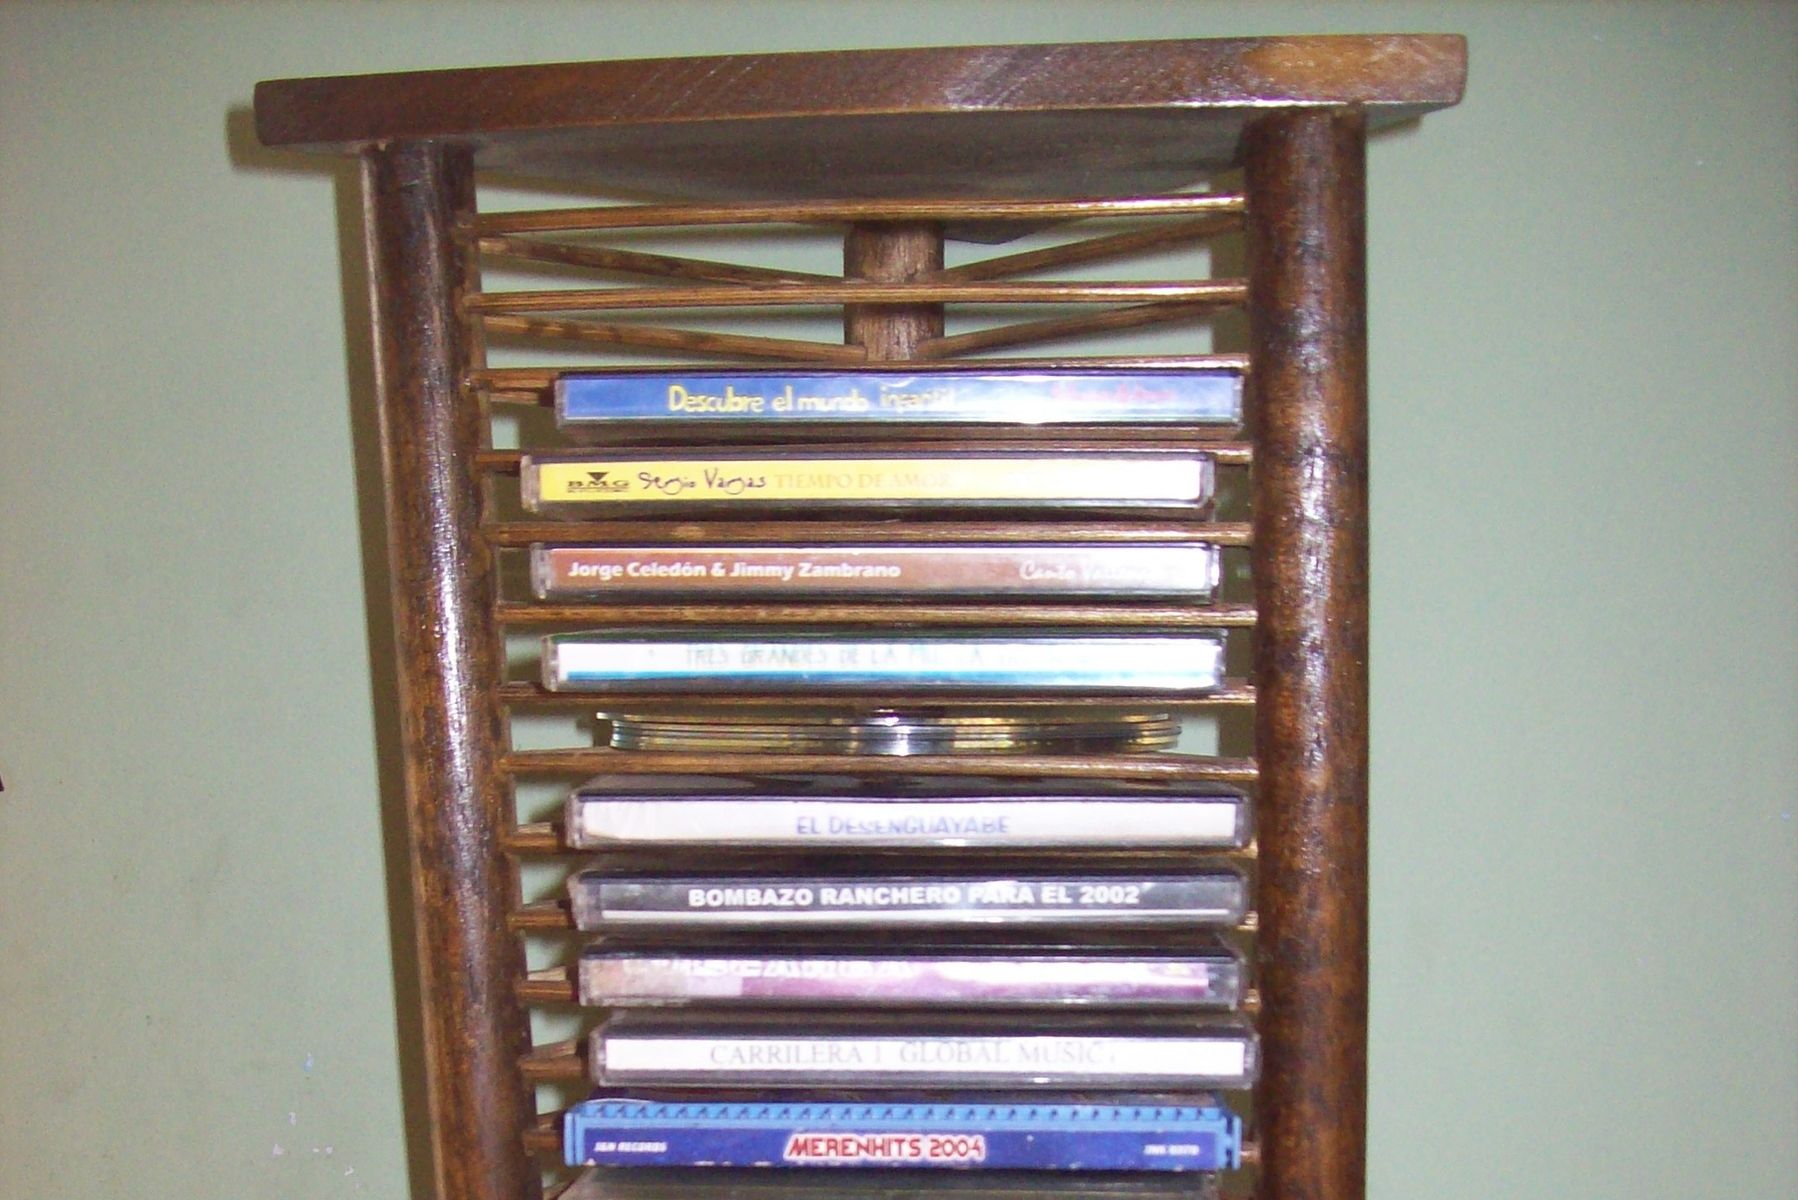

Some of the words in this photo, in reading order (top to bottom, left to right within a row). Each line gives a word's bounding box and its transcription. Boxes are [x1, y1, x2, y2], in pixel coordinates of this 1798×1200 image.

[667, 385, 765, 412] Descubre
[771, 385, 794, 411] el
[797, 388, 870, 411] mundo
[567, 480, 630, 489] BMG
[638, 471, 696, 495] Sergio
[703, 467, 767, 495] Vargas
[774, 474, 852, 489] TIEMPO
[857, 473, 886, 488] DE
[568, 562, 623, 580] Jorge
[627, 559, 706, 577] Celedón
[710, 562, 726, 577] &
[730, 562, 794, 580] Jimmy
[798, 563, 901, 579] Zambrano
[797, 816, 821, 834] EL
[688, 888, 814, 906] BOMBAZO
[819, 886, 962, 905] RANCHERO
[968, 885, 1036, 904] PARA
[1040, 886, 1074, 904] EL
[1078, 885, 1141, 904] 2002
[710, 1044, 864, 1066] CARRILERA
[899, 1042, 1009, 1065] GLOBAL
[788, 1137, 921, 1158] MERENHITS
[929, 1138, 983, 1158] 2004
